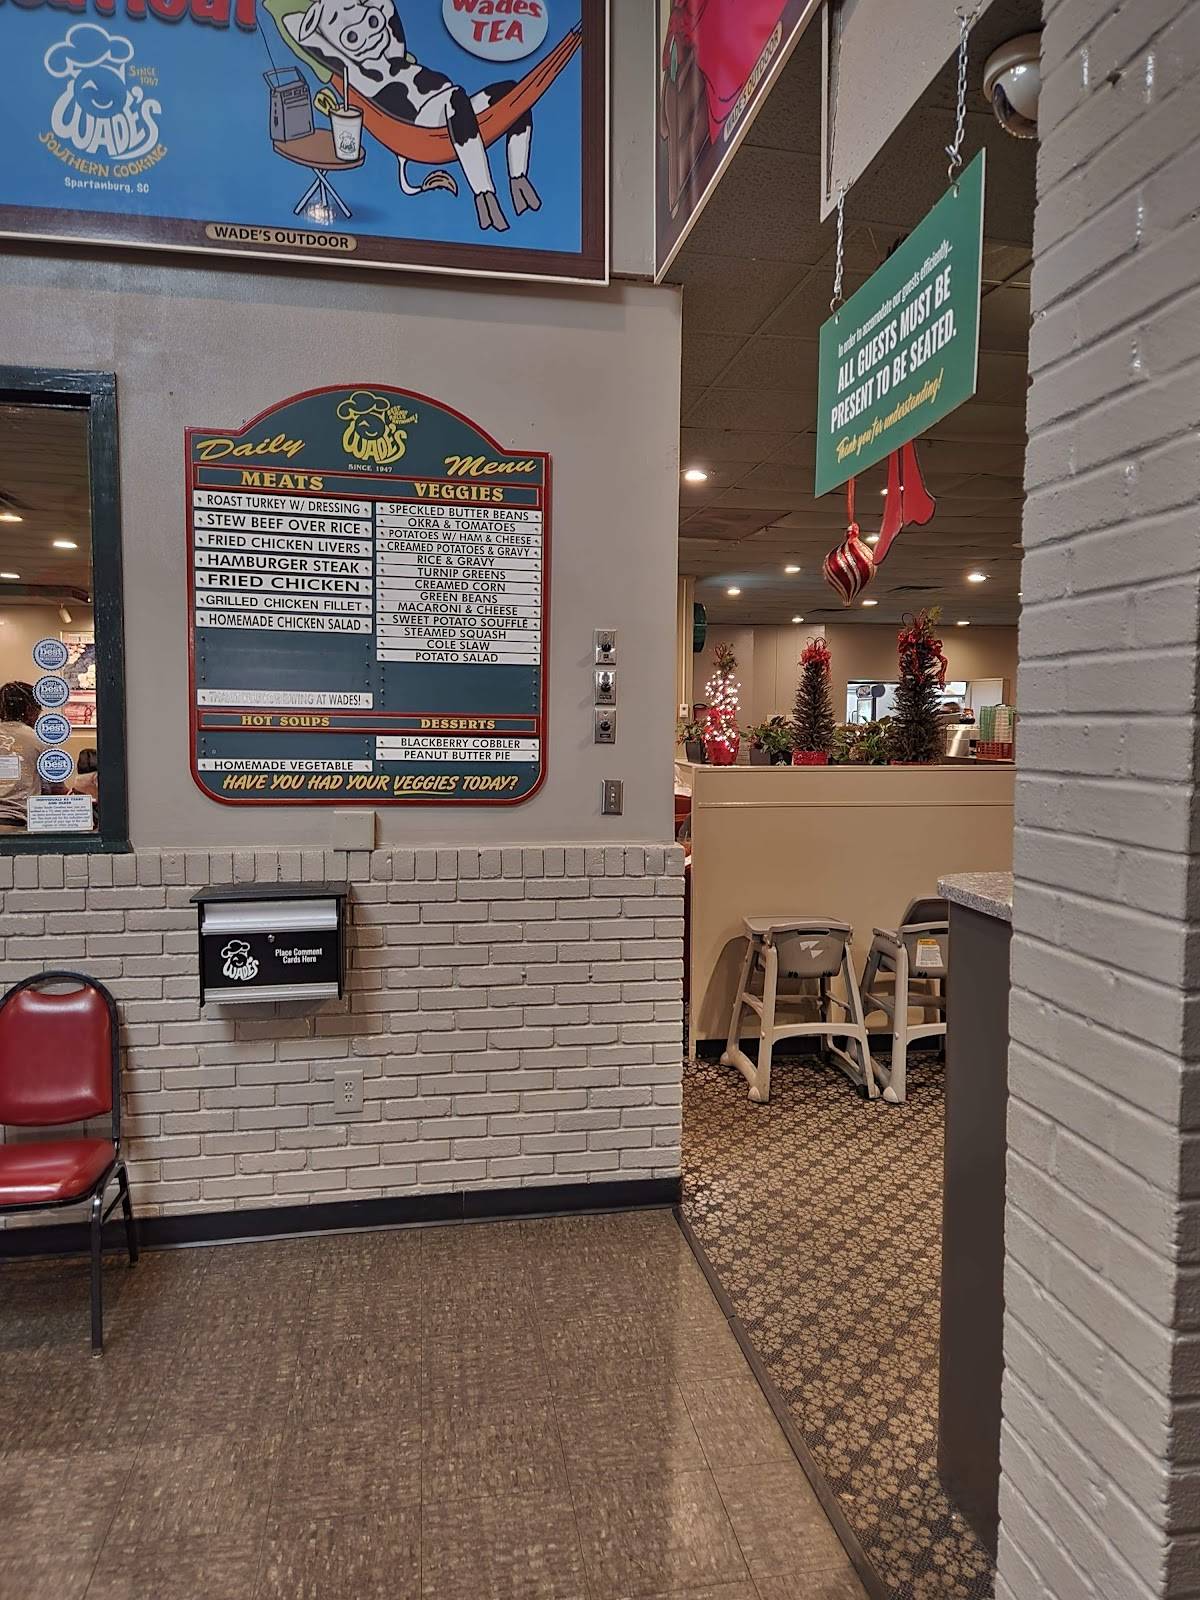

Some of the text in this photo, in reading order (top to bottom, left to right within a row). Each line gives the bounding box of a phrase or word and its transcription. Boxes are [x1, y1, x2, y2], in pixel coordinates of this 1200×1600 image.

[471, 19, 524, 44] TEA
[51, 79, 162, 161] WADE'S
[38, 131, 168, 178] SOUTHERN COOKING
[137, 182, 150, 193] SC
[214, 226, 349, 249] WADE'S OUTDOOR
[902, 272, 920, 302] guests
[837, 264, 952, 394] ALL GUESTS MUST BE
[830, 308, 957, 434] PRESENT TO BE SEATED.
[342, 420, 408, 464] WADE'S
[196, 433, 537, 477] Daily Menu
[348, 463, 372, 472] SINCE
[240, 471, 324, 491] MEATS
[414, 482, 504, 501] VEGGIES
[207, 494, 361, 514] ROAST TURKEY W/ DRESSING
[389, 504, 529, 521] SPECKLED BUTTER BEANS
[207, 514, 361, 535] STEW BEEF OVER RICE
[407, 518, 516, 532] OKRA & TOMATOES
[208, 534, 361, 554] FRIED CHICKEN LIVERS
[389, 529, 532, 545] POTATOES W/ HAM & CHEESE
[387, 541, 530, 557] CREAMED POTATOES & GRAVY
[208, 554, 360, 574] HAMBURGER STEAK
[417, 555, 495, 567] RICE & GRAVY
[417, 567, 506, 580] TURNIP GREENS
[208, 574, 360, 592] FRIED CHICKEN
[414, 579, 506, 592] CREAMED CORN
[206, 594, 362, 612] GRILLED CHICKEN FILLET
[420, 591, 498, 604] GREEN BEANS
[397, 602, 518, 616] MACARONI & CHEESE
[209, 613, 361, 631] HOMEMADE CHICKEN SALAD
[392, 615, 430, 625] SWEET
[433, 616, 477, 627] POTATO
[404, 627, 506, 640] STEAMED SQUASH
[40, 646, 63, 656] best
[426, 639, 490, 650] COLE SLAW
[415, 652, 498, 663] POTATO SALAD
[41, 683, 64, 693] best
[316, 693, 327, 705] AT
[328, 694, 361, 706] WADES!
[42, 723, 65, 733] best
[241, 715, 330, 727] HOT SOUPS
[420, 719, 496, 730] DESSERTS
[401, 737, 520, 749] BLACKBERRY COBBLER
[404, 750, 511, 761] PEANUT BUTTER PIE
[44, 759, 67, 769] best
[214, 760, 354, 771] HOMEMADE VEGETABLE
[222, 774, 519, 792] HAVE YOU HAD YOUR VEGGIES TODAY?
[275, 947, 322, 957] Place Comment
[282, 955, 317, 964] Cards Here
